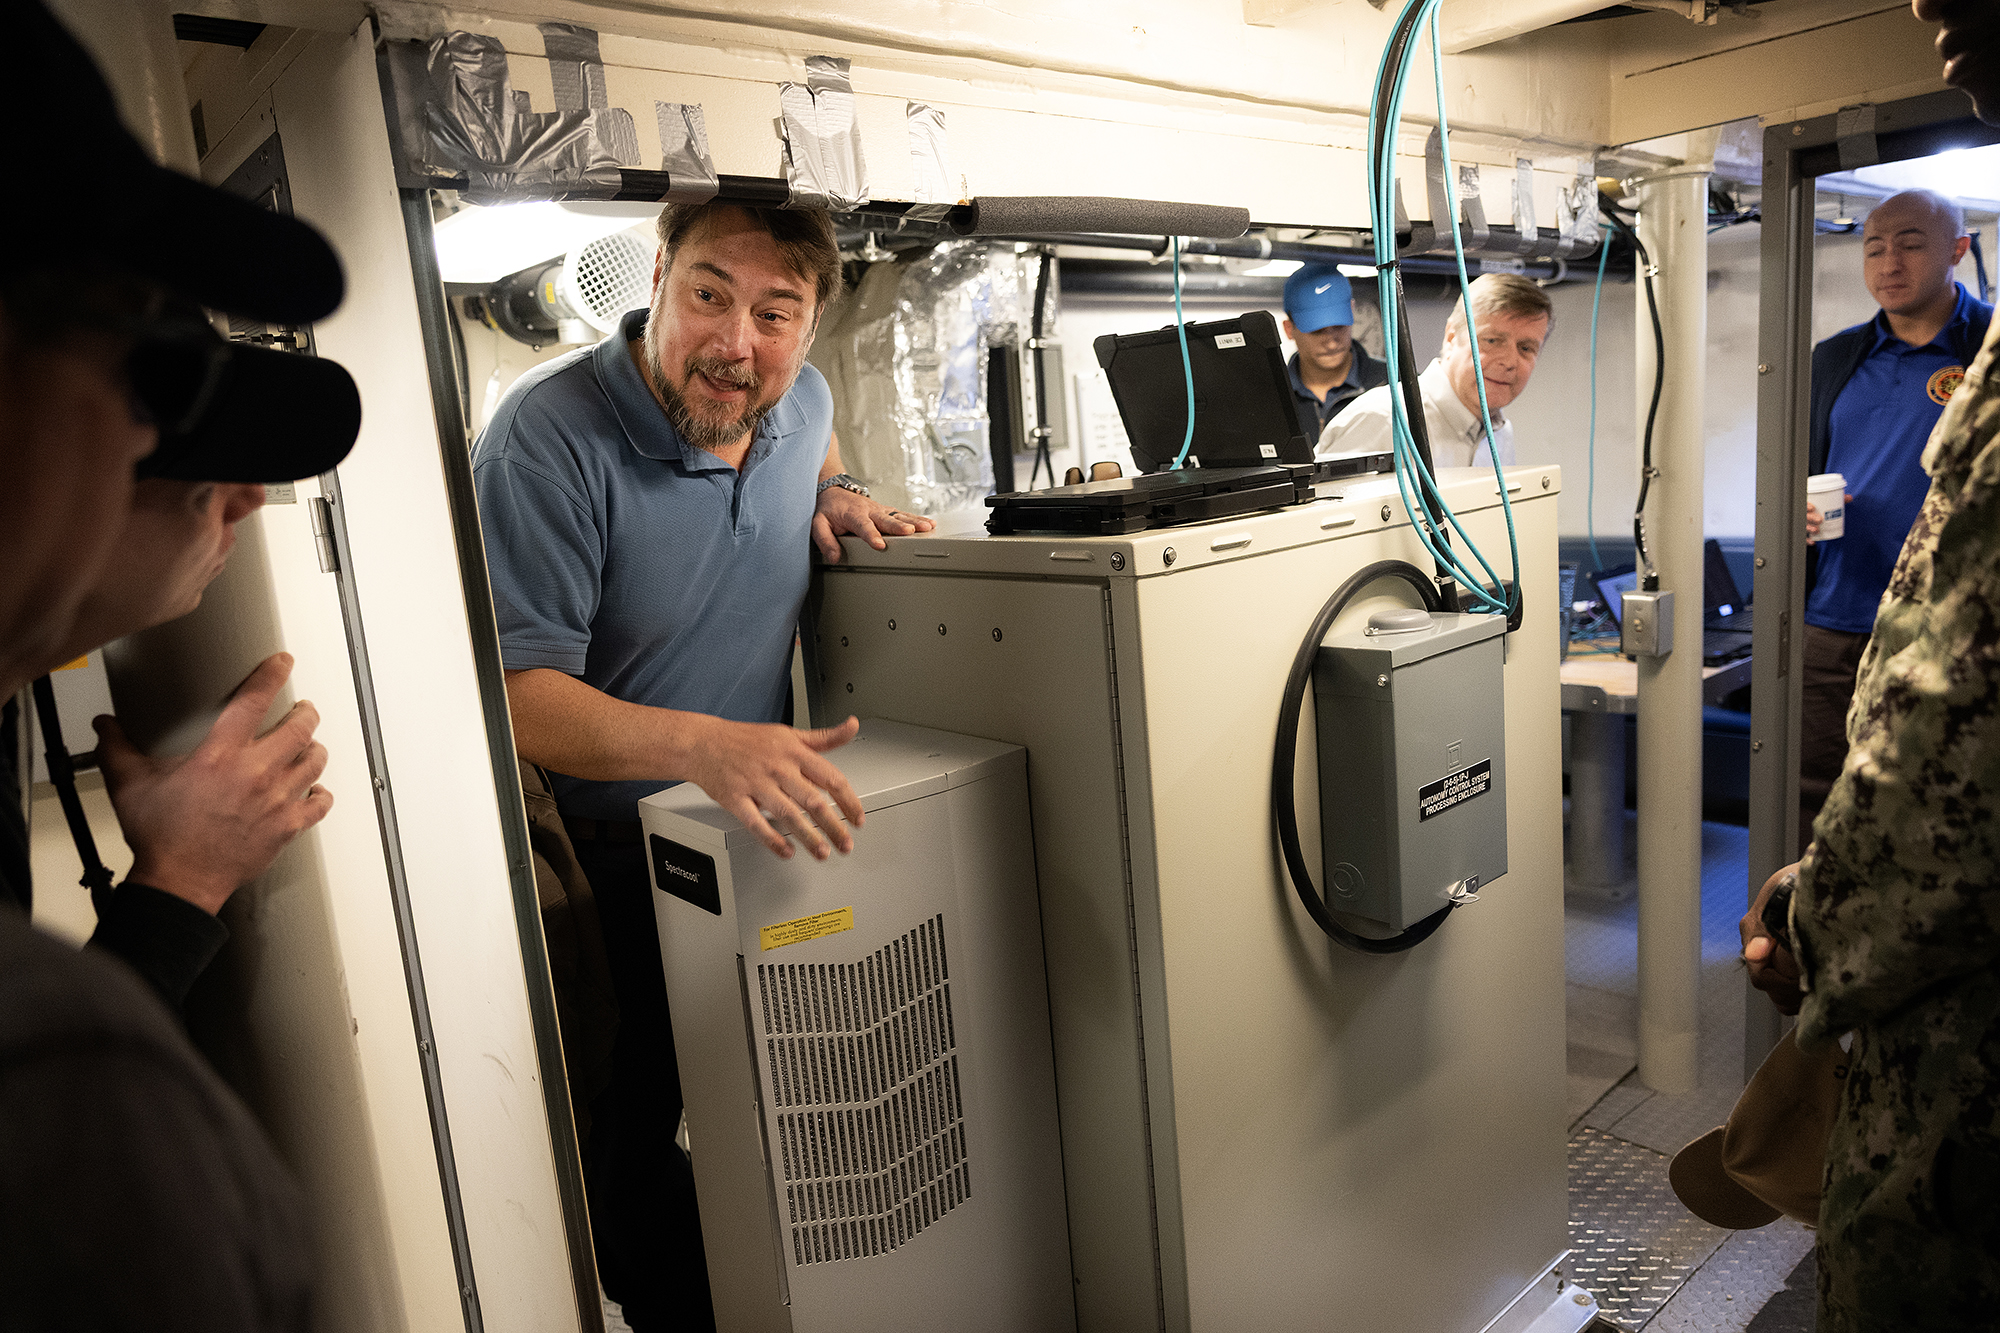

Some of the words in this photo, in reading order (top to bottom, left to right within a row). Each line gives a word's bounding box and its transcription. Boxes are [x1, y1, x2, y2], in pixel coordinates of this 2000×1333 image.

[1420, 789, 1448, 808] AUTONOMY
[1449, 778, 1471, 798] CONTROL
[1472, 770, 1490, 786] SYSTEM
[1426, 795, 1457, 816] PROCESSING
[1458, 782, 1486, 801] ENCLOSURE
[788, 918, 807, 926] Operation
